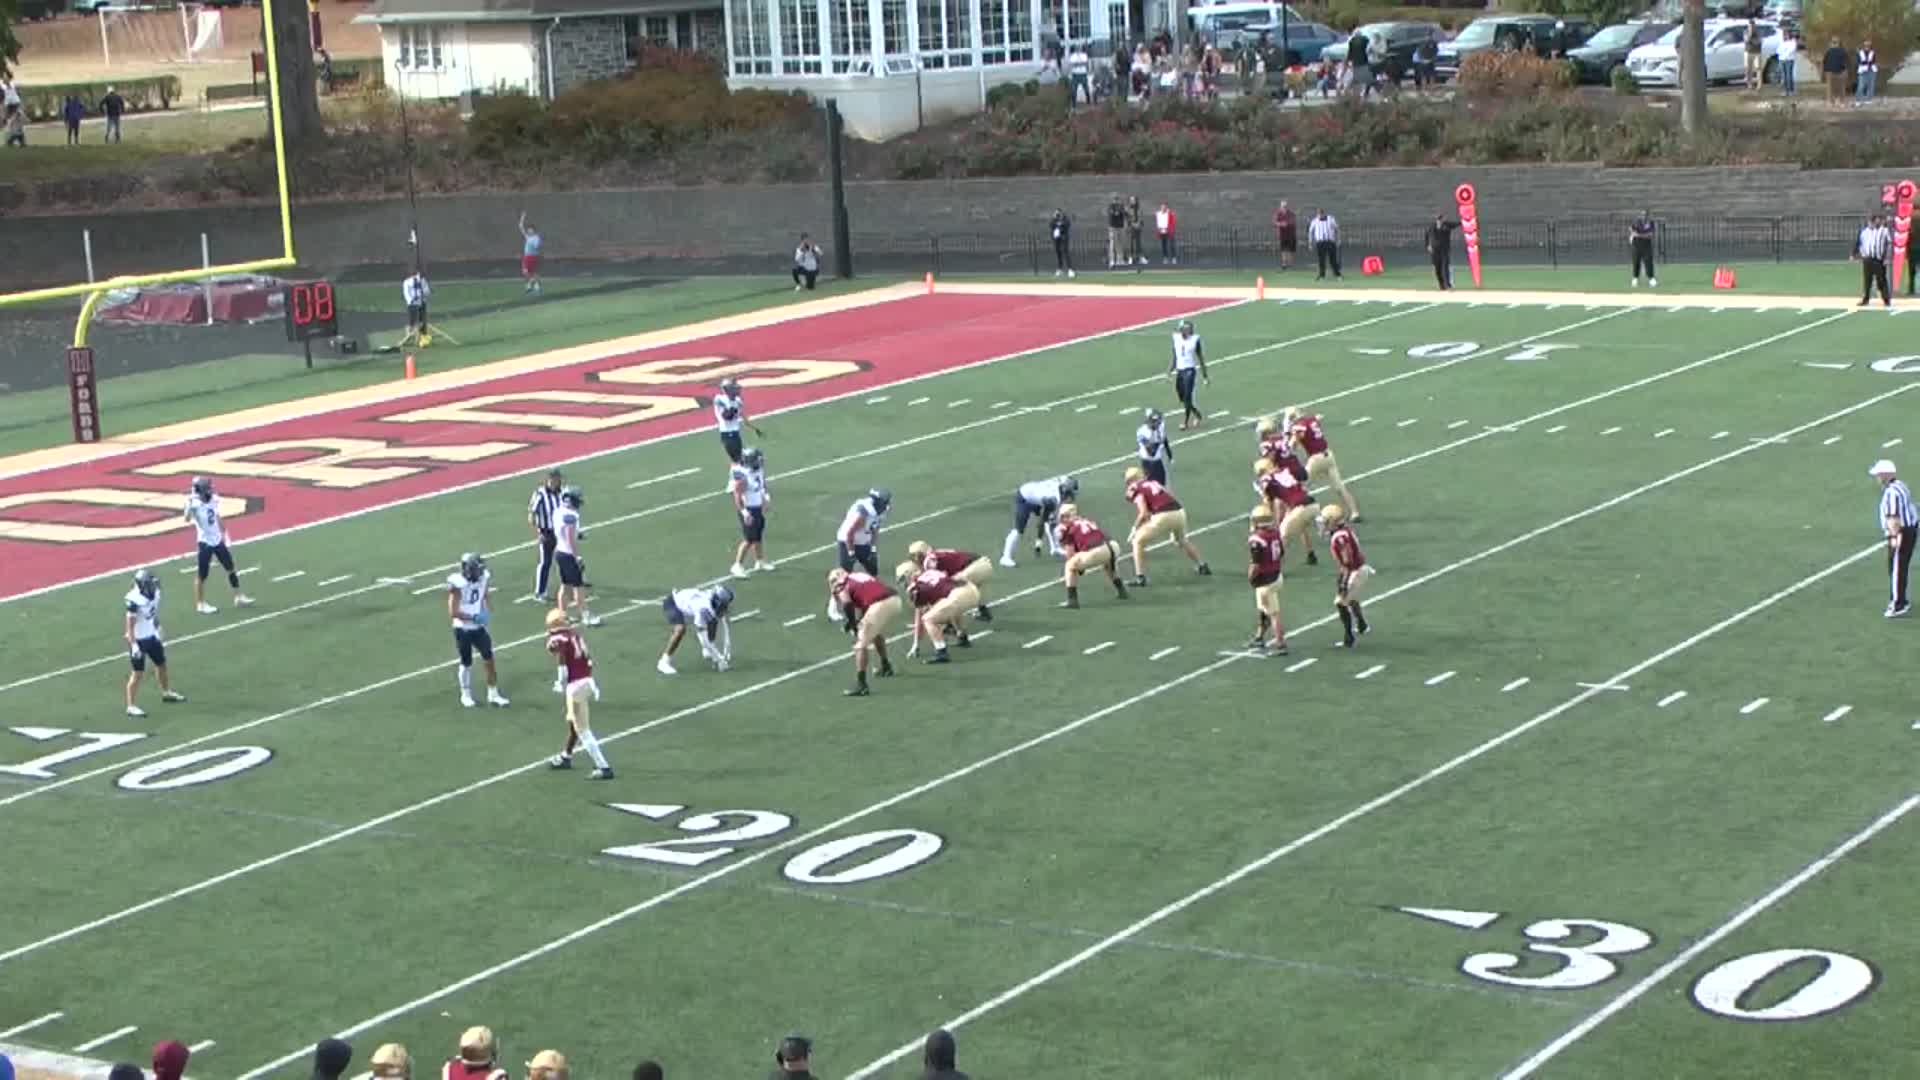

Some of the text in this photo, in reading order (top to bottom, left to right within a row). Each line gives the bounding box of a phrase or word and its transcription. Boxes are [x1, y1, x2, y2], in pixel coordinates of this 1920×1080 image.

[291, 281, 333, 325] 08
[207, 508, 215, 526] 2
[0, 732, 273, 790] 10
[600, 808, 945, 884] 20
[1460, 918, 1877, 1022] 30
